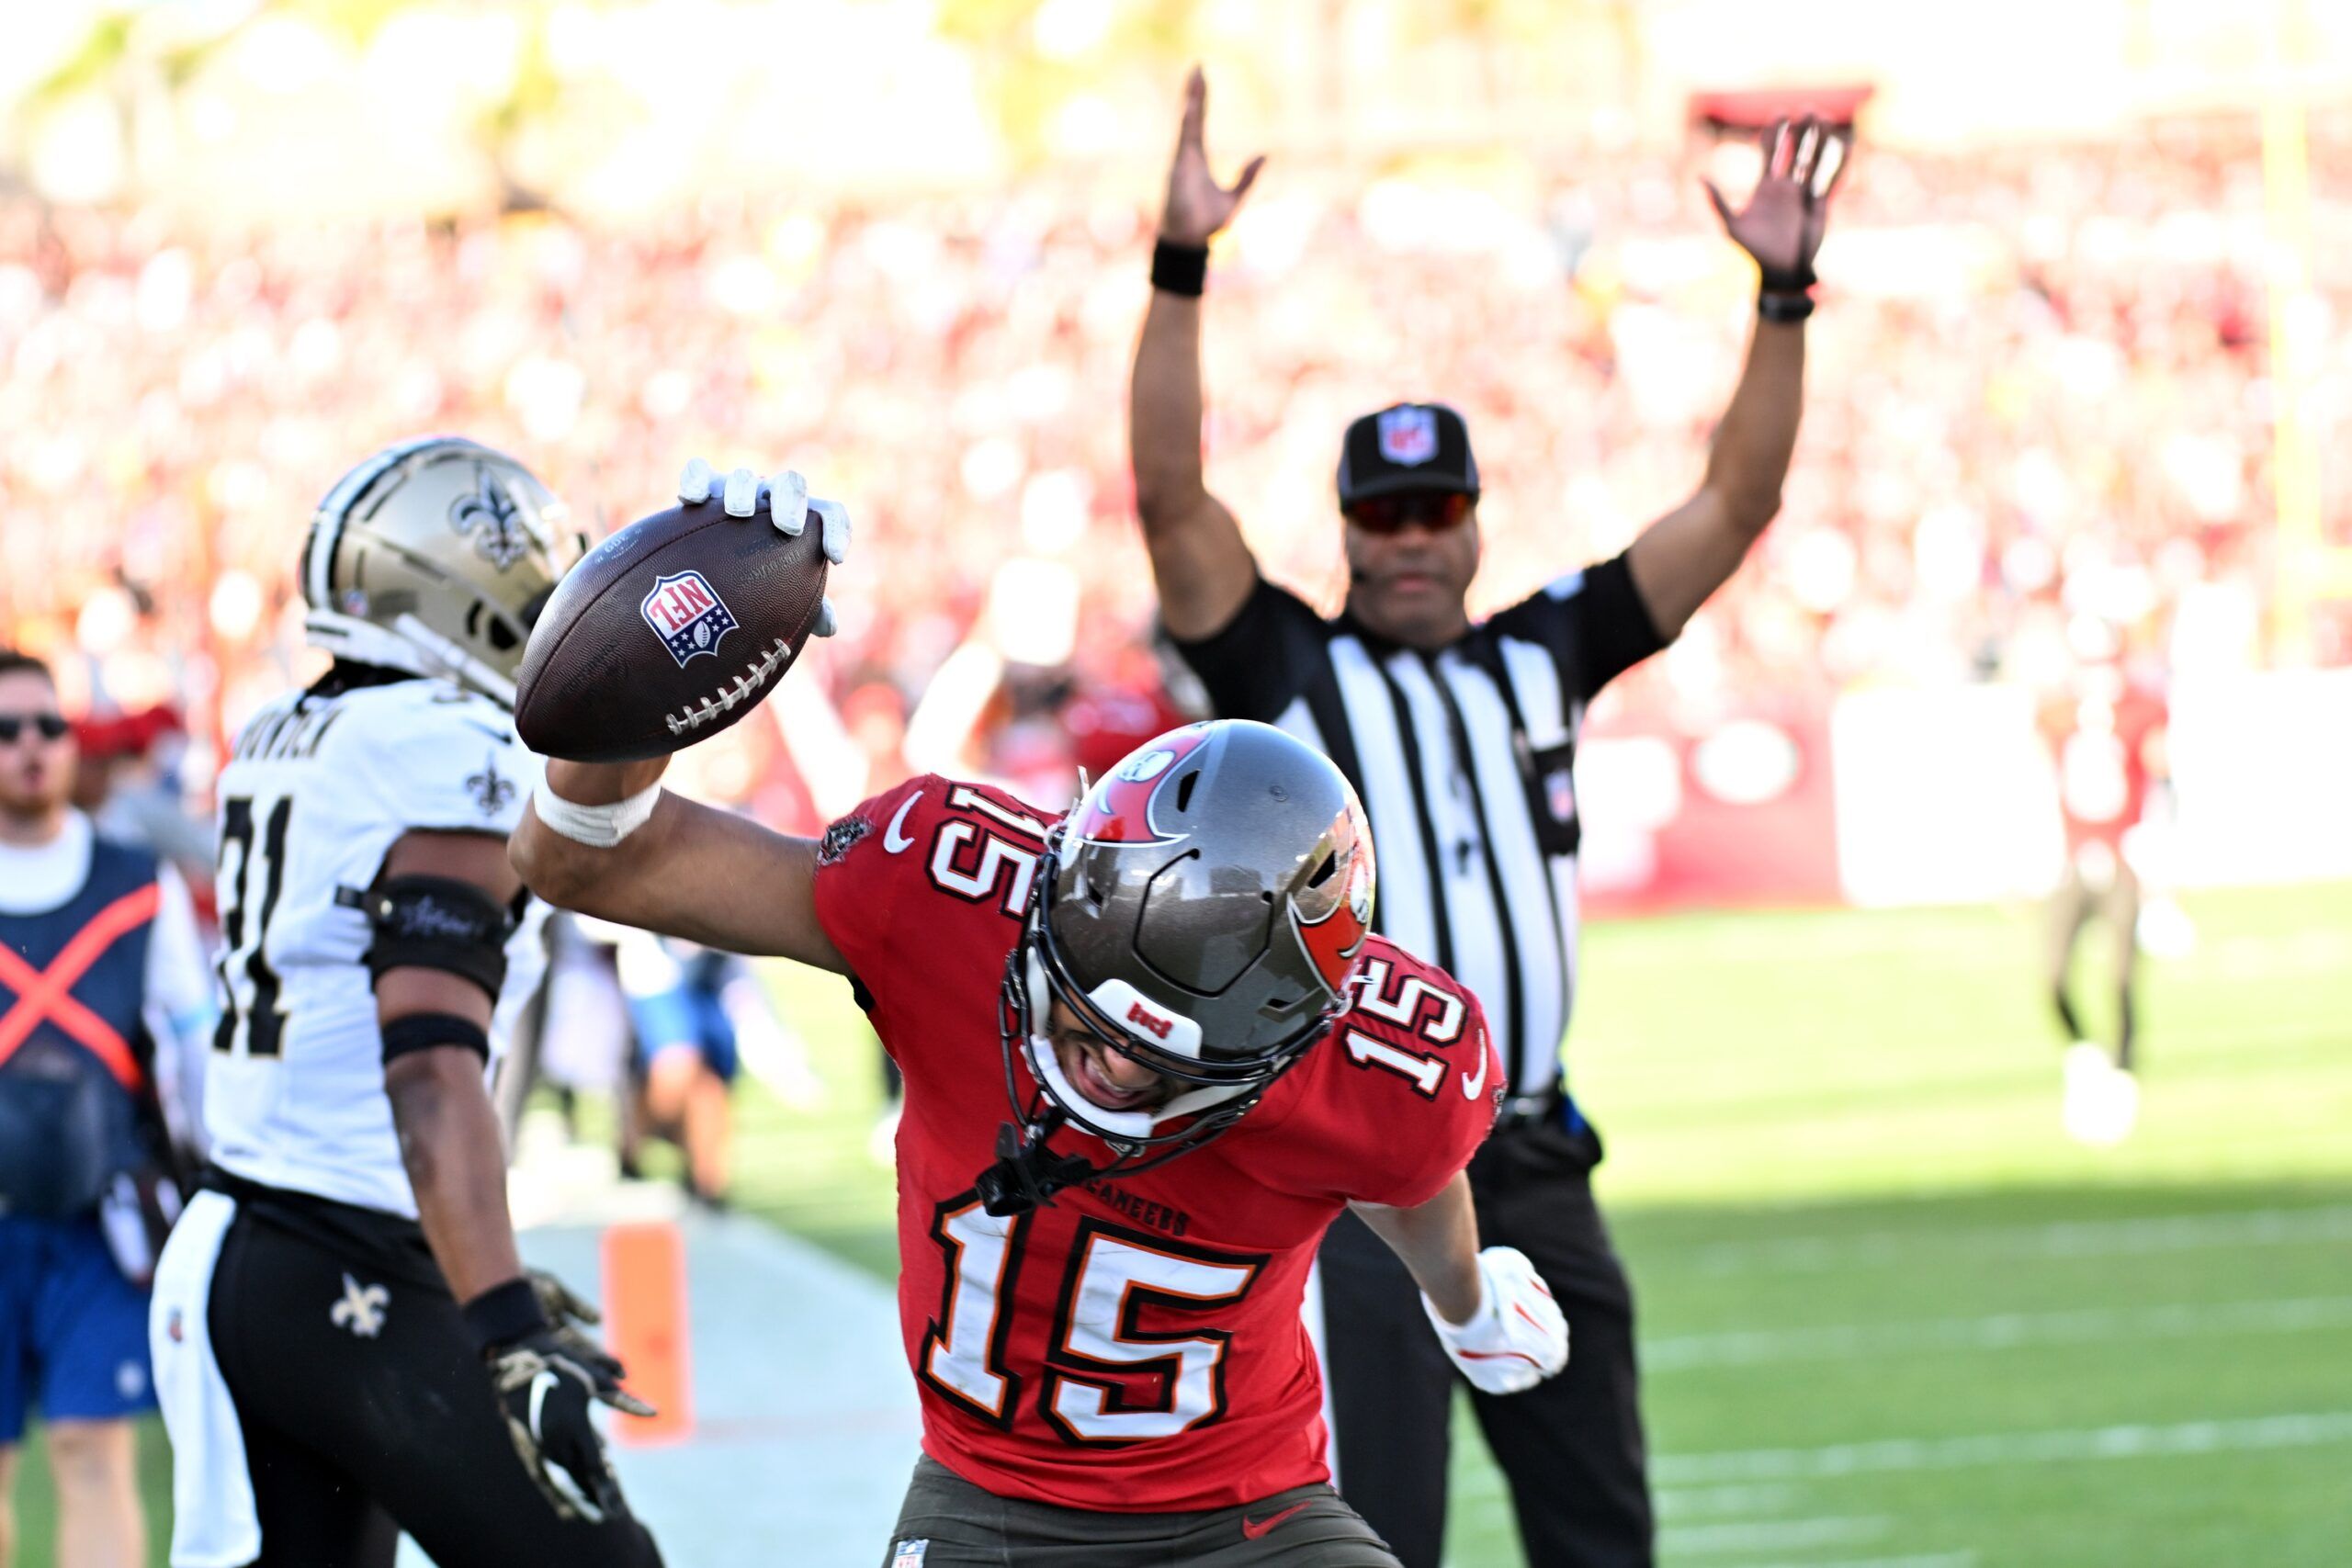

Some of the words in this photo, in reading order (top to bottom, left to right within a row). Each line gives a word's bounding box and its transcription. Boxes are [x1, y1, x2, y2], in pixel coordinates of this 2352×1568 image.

[649, 578, 714, 632] NFL
[925, 784, 1046, 922] 15
[1340, 955, 1469, 1101] 15
[917, 1185, 1271, 1450] 15
